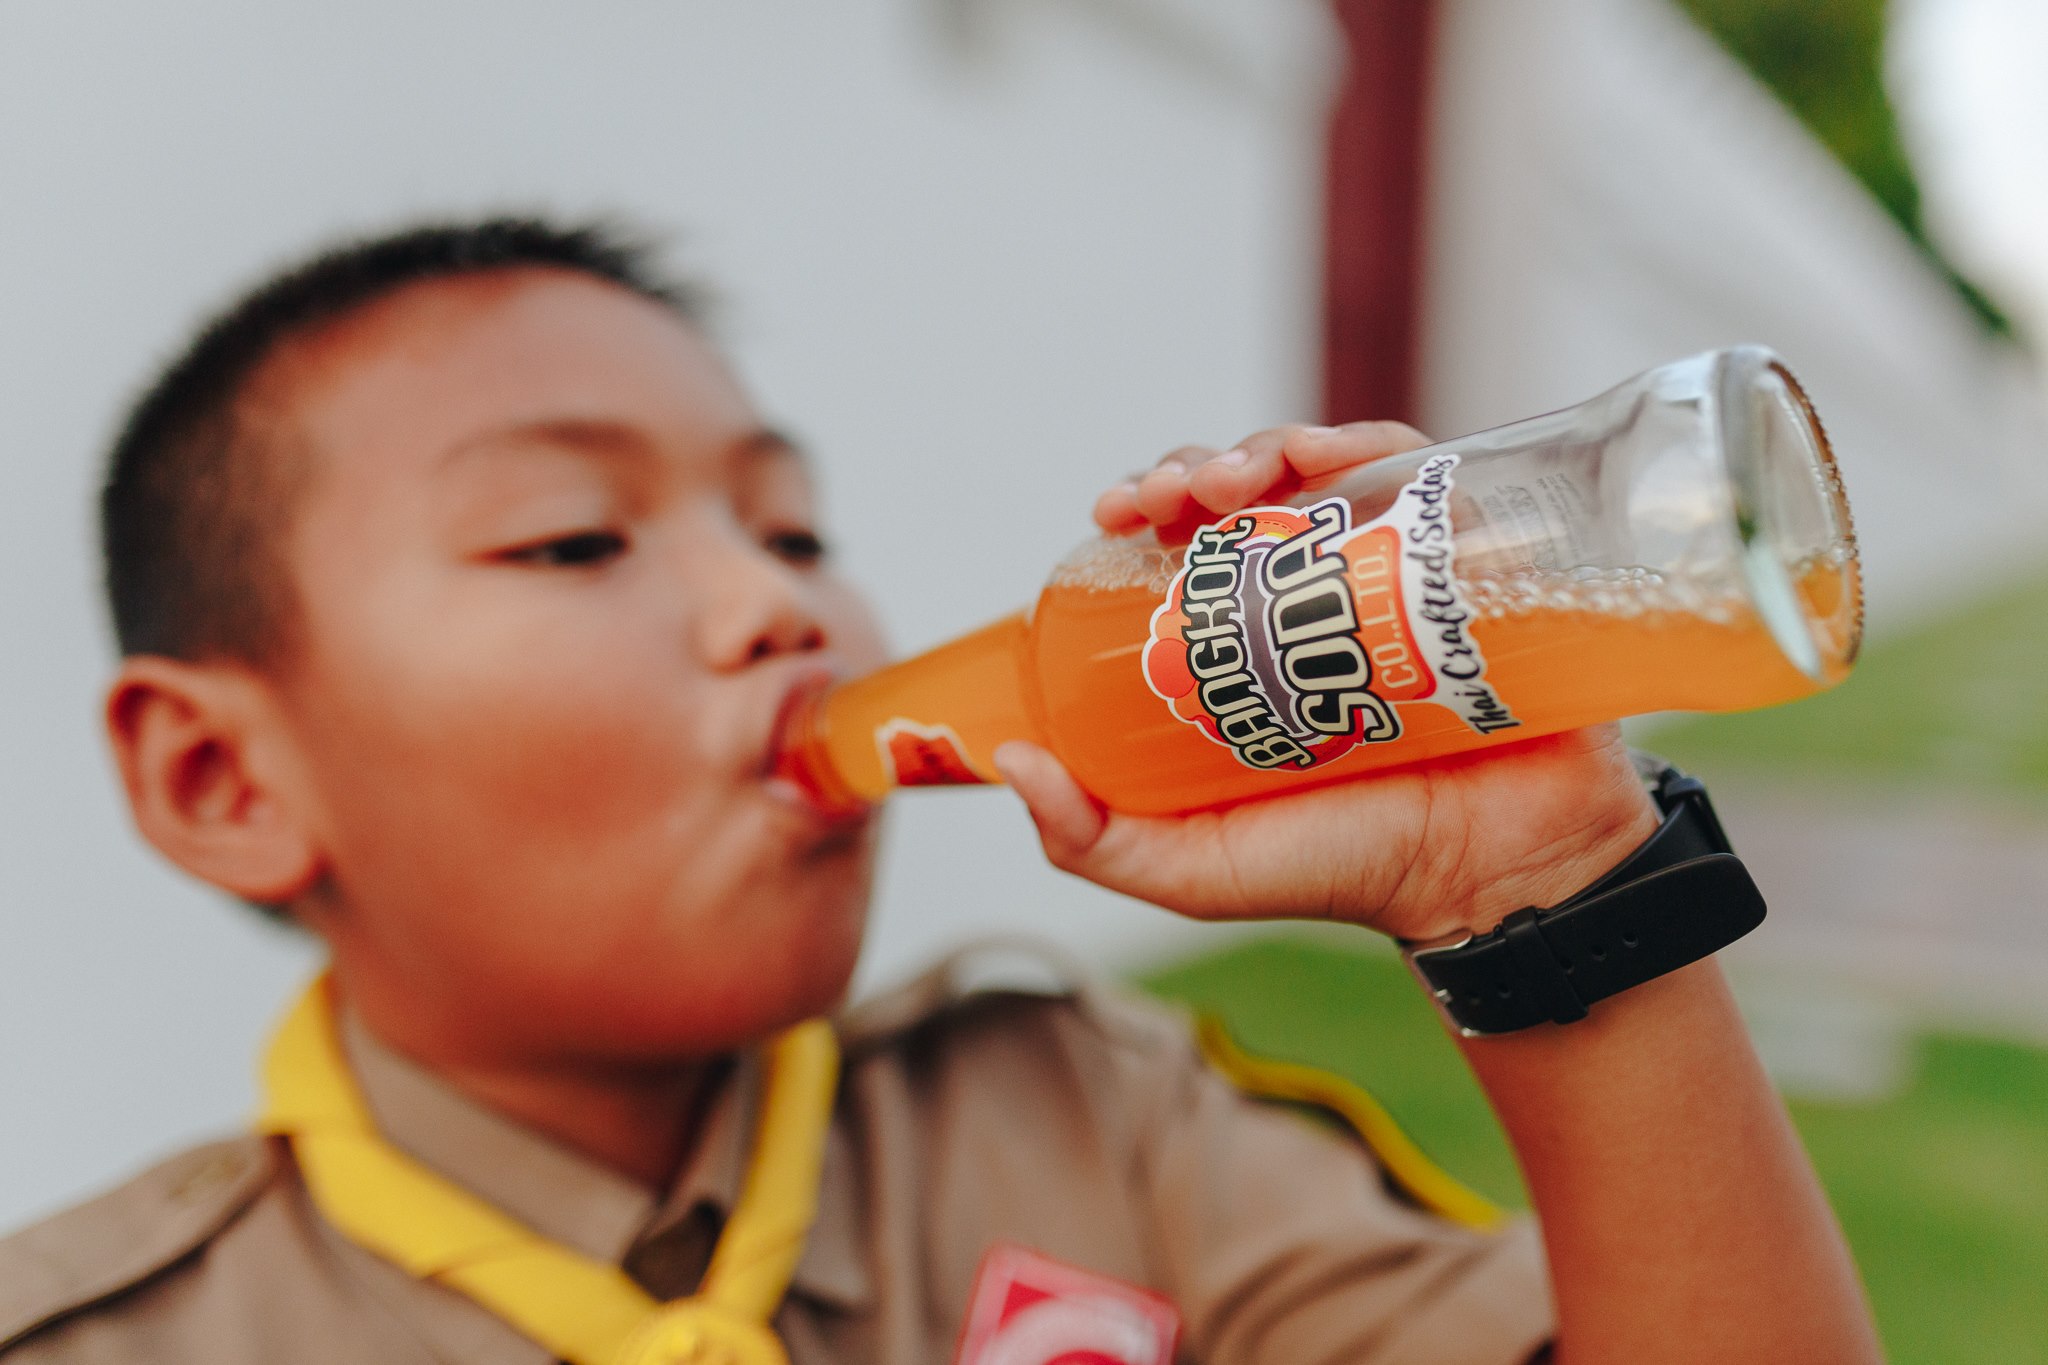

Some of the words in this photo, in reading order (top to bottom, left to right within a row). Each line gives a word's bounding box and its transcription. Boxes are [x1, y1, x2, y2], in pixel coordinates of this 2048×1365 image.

[1406, 459, 1454, 543] Sodas
[1181, 516, 1318, 769] BANGKOK
[1261, 501, 1401, 743] SODA
[1406, 546, 1481, 681] Crafted
[1454, 685, 1522, 734] Thai
